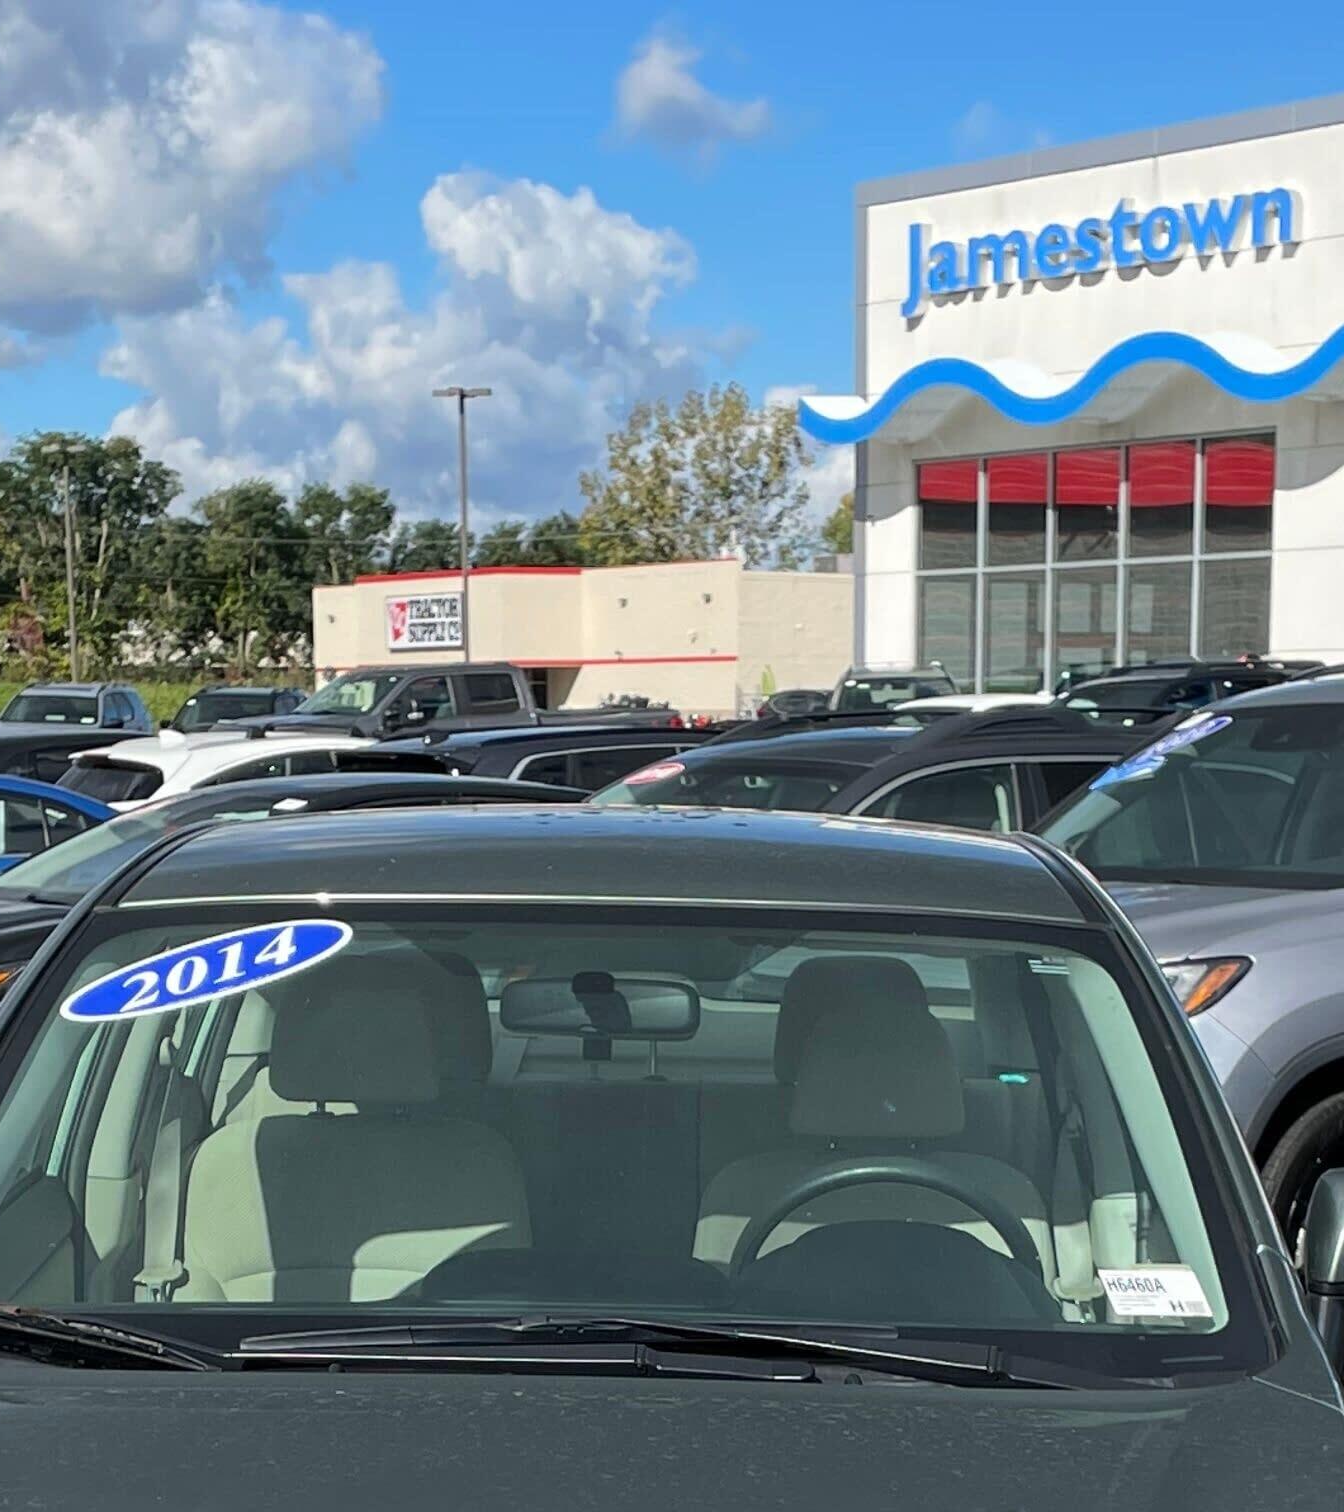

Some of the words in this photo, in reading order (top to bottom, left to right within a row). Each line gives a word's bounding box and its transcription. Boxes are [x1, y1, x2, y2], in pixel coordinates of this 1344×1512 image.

[900, 187, 1293, 318] Jamestown
[407, 598, 461, 618] TRACTOR
[119, 926, 297, 1013] 2014
[1105, 1277, 1167, 1293] H6460A
